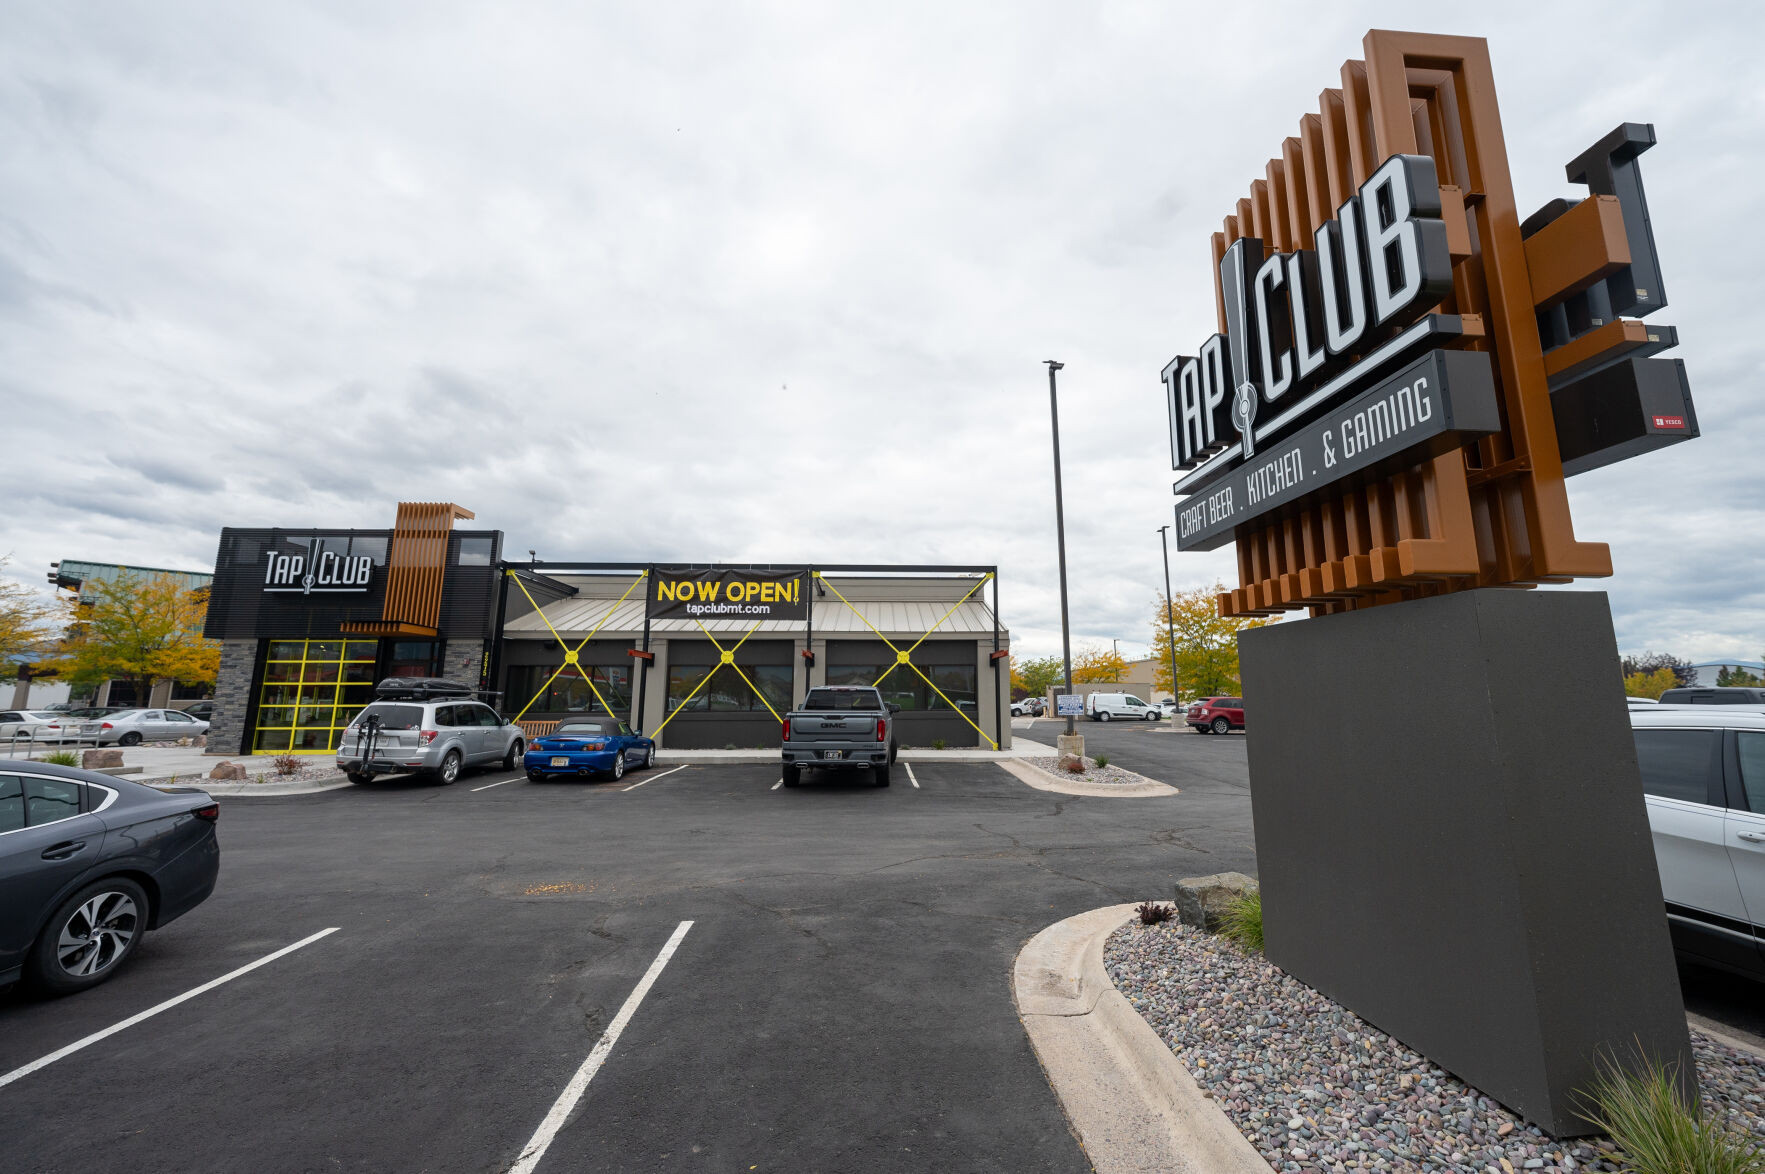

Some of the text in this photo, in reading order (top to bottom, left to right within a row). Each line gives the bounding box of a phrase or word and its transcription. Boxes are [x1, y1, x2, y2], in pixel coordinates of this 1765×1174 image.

[1162, 154, 1423, 470] TAP CLUB
[1180, 504, 1207, 539] CRAFT
[1209, 490, 1234, 525] BEER
[1246, 447, 1304, 507] KITCHEN
[1322, 430, 1337, 469] &
[1342, 376, 1432, 459] GAMING
[265, 551, 372, 584] TAP CLUB
[657, 580, 721, 602] NOW
[686, 603, 770, 615] tapclubmt.com
